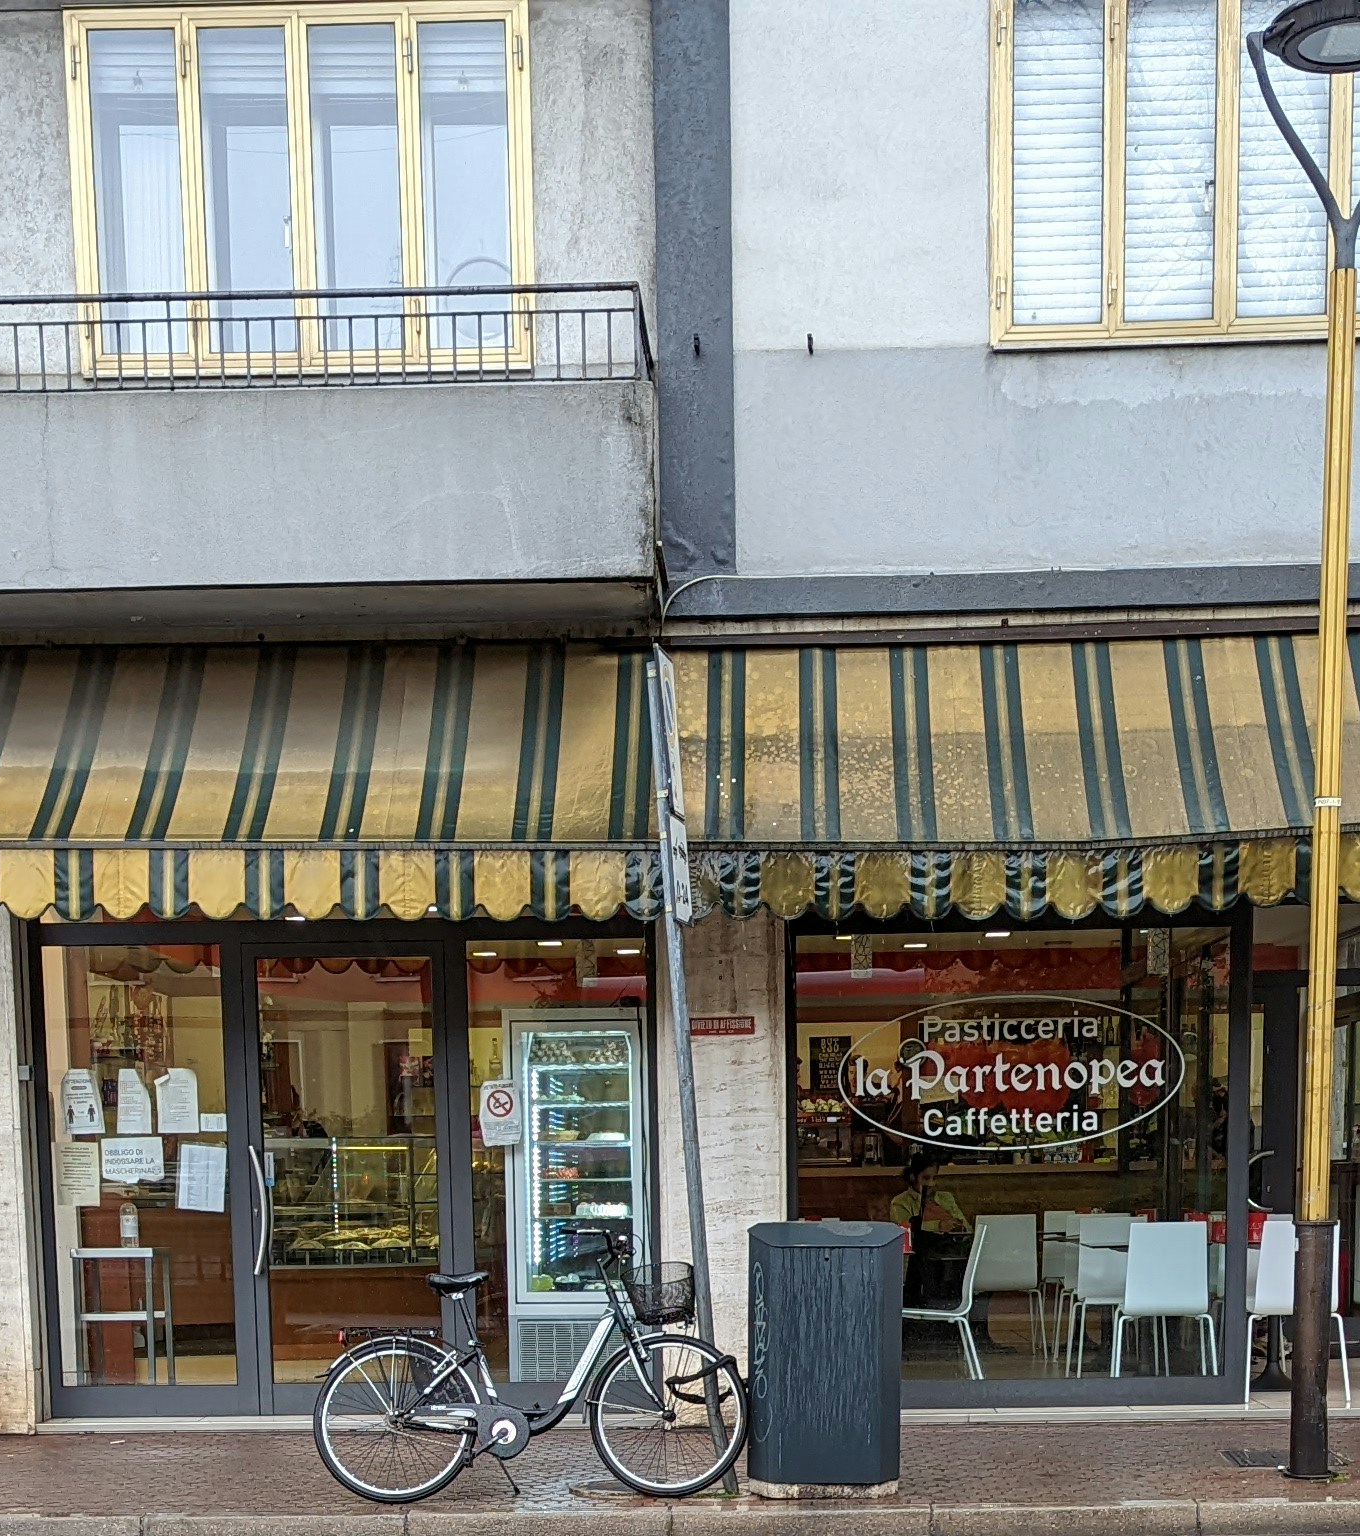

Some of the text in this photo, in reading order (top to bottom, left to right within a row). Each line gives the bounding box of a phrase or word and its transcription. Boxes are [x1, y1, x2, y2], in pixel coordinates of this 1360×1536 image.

[922, 1010, 1099, 1043] Pasticceria
[855, 1055, 892, 1097] la
[900, 1050, 1167, 1101] Partenopea
[922, 1104, 1099, 1137] Caffetteria
[104, 1148, 134, 1156] OBBLIGO
[104, 1157, 156, 1165] INDOSSARE LA
